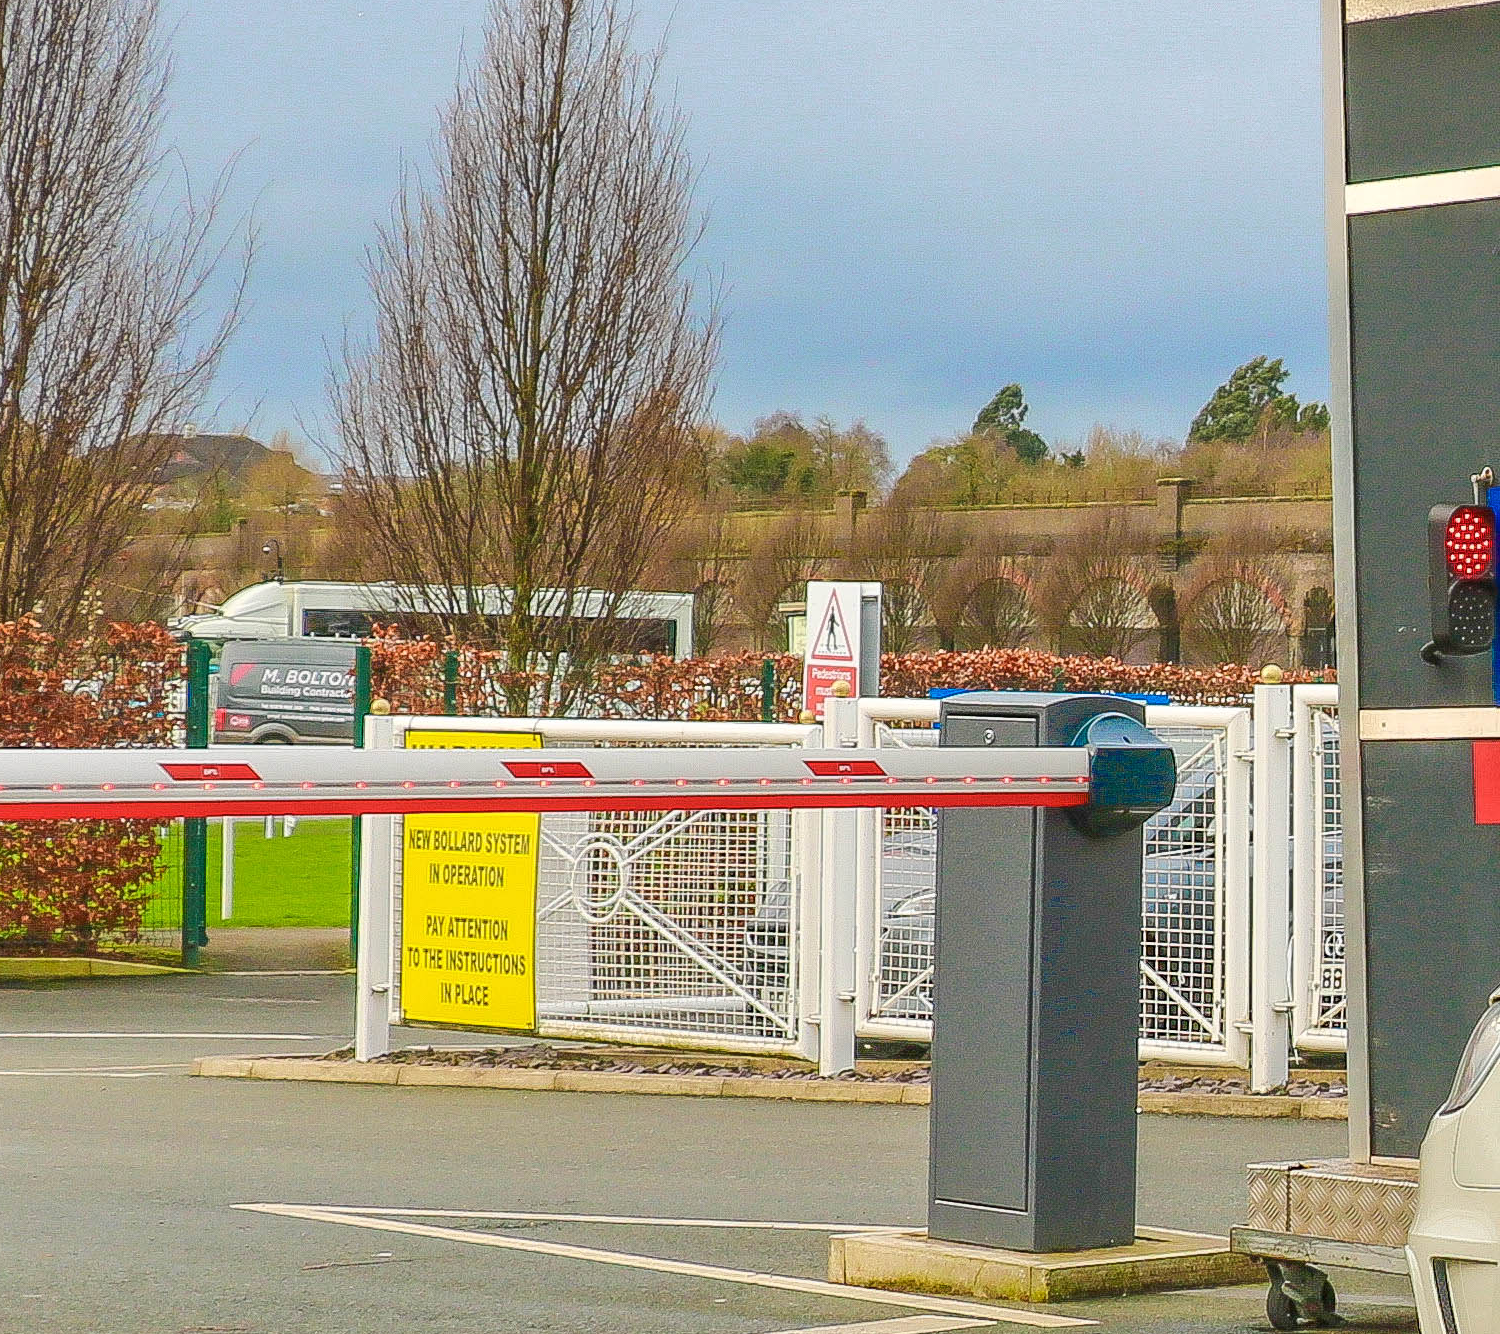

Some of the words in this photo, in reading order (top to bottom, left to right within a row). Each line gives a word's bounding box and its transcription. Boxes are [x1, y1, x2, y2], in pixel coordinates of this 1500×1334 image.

[409, 828, 431, 850] NEW
[433, 831, 483, 853] BOLLARD
[485, 833, 530, 855] SYSTEM
[429, 862, 440, 884] IN
[443, 864, 505, 888] OPERATION
[426, 915, 444, 936] PAY
[447, 917, 508, 941] ATTENTION
[407, 946, 420, 968] TO
[423, 947, 443, 970] THE
[445, 951, 527, 976] INSTRUCTIONS
[440, 982, 452, 1004] IN
[454, 983, 489, 1006] PLACE
